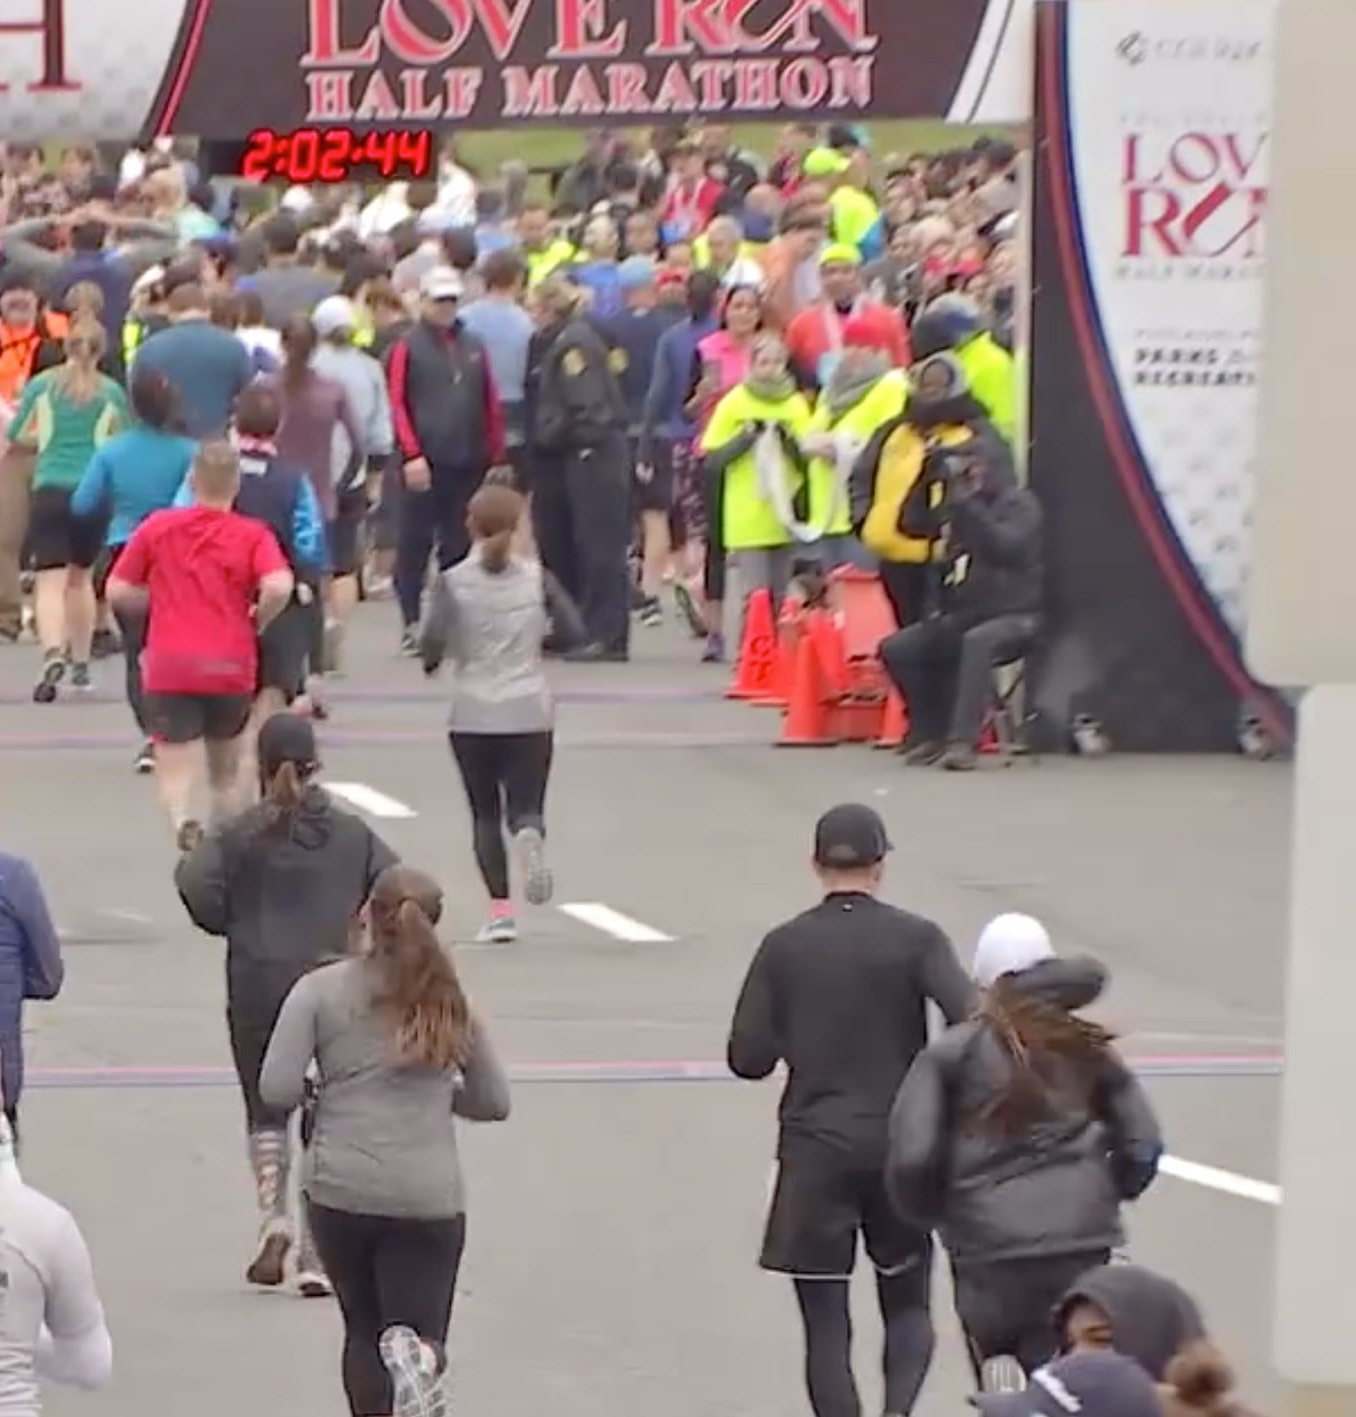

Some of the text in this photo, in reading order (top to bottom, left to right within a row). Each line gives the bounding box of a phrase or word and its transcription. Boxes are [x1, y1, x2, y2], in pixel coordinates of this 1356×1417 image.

[300, 0, 624, 66] LOVE
[306, 56, 877, 121] HALF MARATHON
[242, 130, 429, 183] 2:02:44
